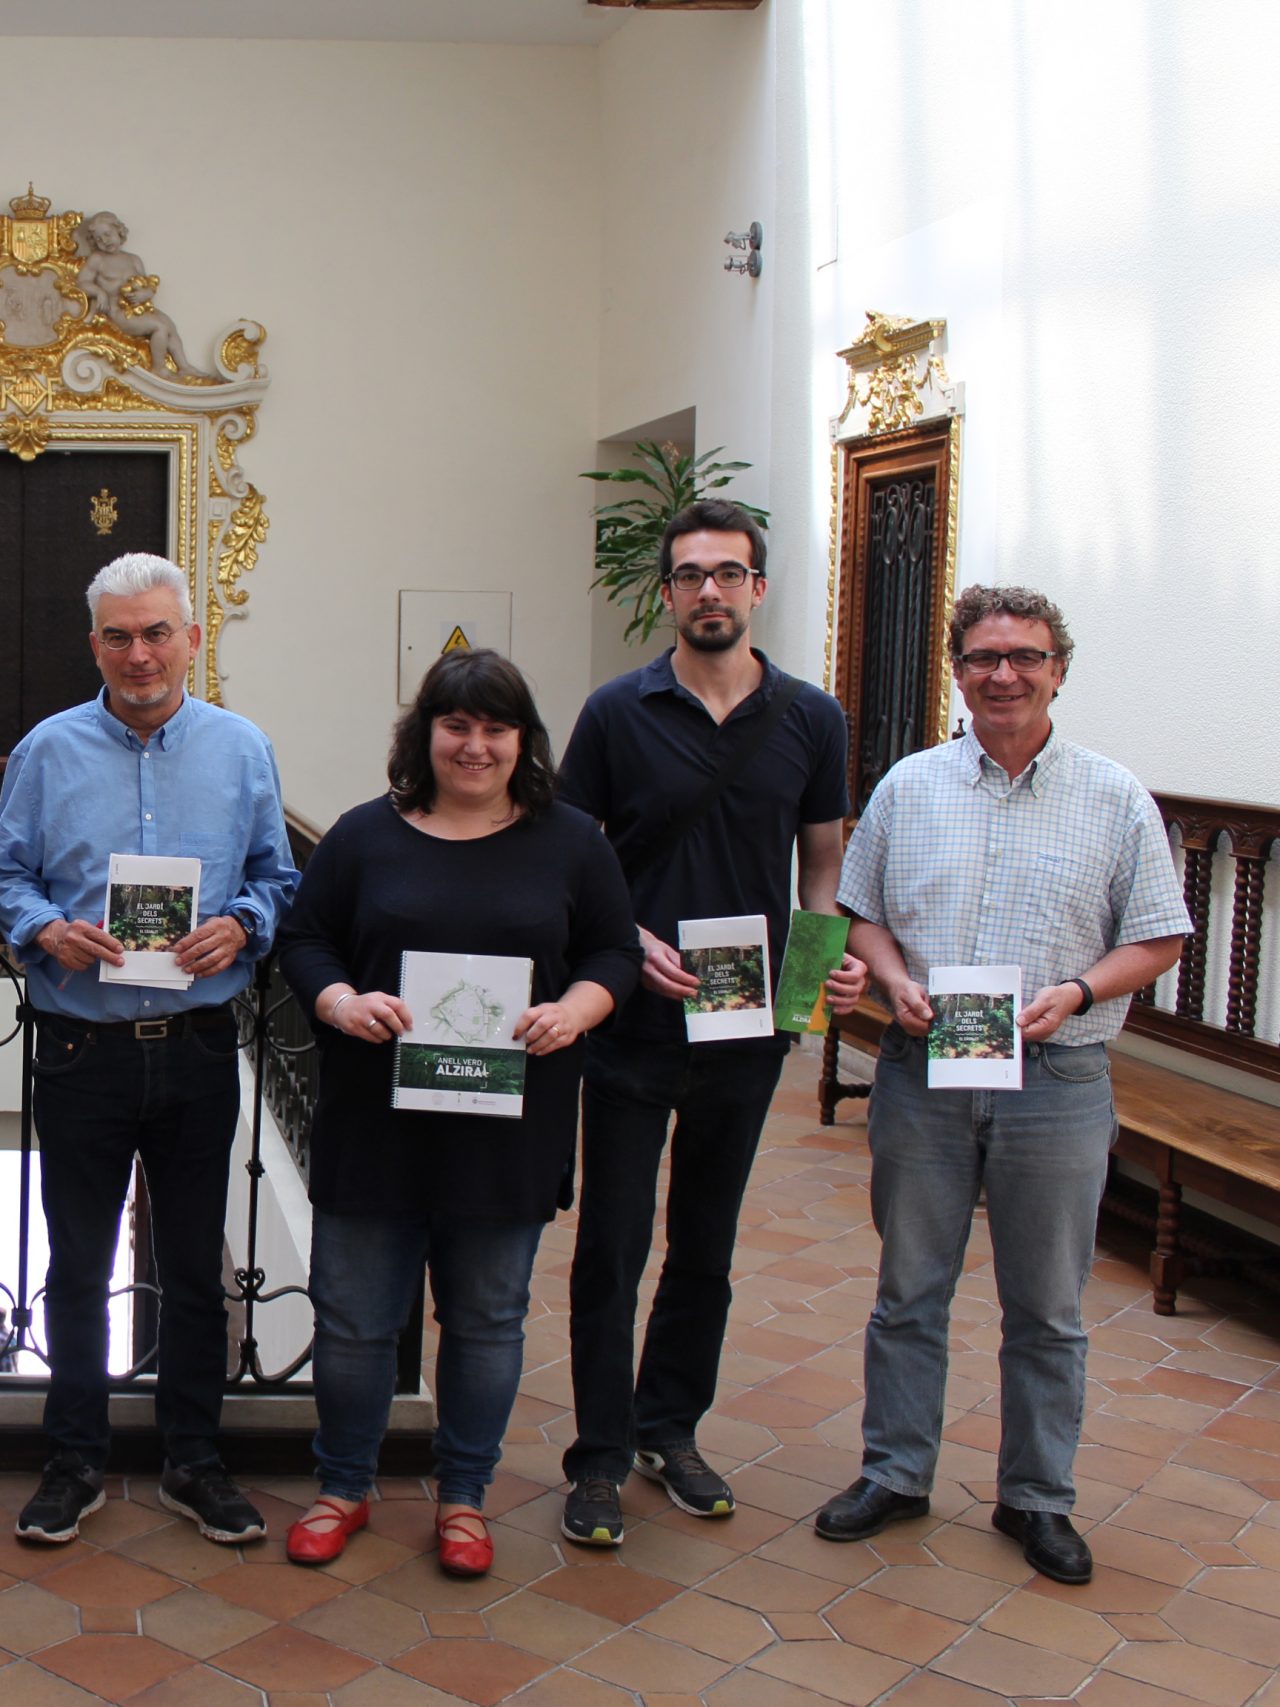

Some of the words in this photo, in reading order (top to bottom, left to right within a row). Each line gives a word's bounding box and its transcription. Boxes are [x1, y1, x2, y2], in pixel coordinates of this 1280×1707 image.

[137, 917, 162, 925] SECRETS
[710, 977, 736, 985] SECRETS
[961, 1017, 977, 1025] DELS
[956, 1024, 983, 1032] SECRETS
[437, 1057, 462, 1066] ANELL
[462, 1058, 483, 1067] VERD
[435, 1064, 483, 1078] ALZIRA
